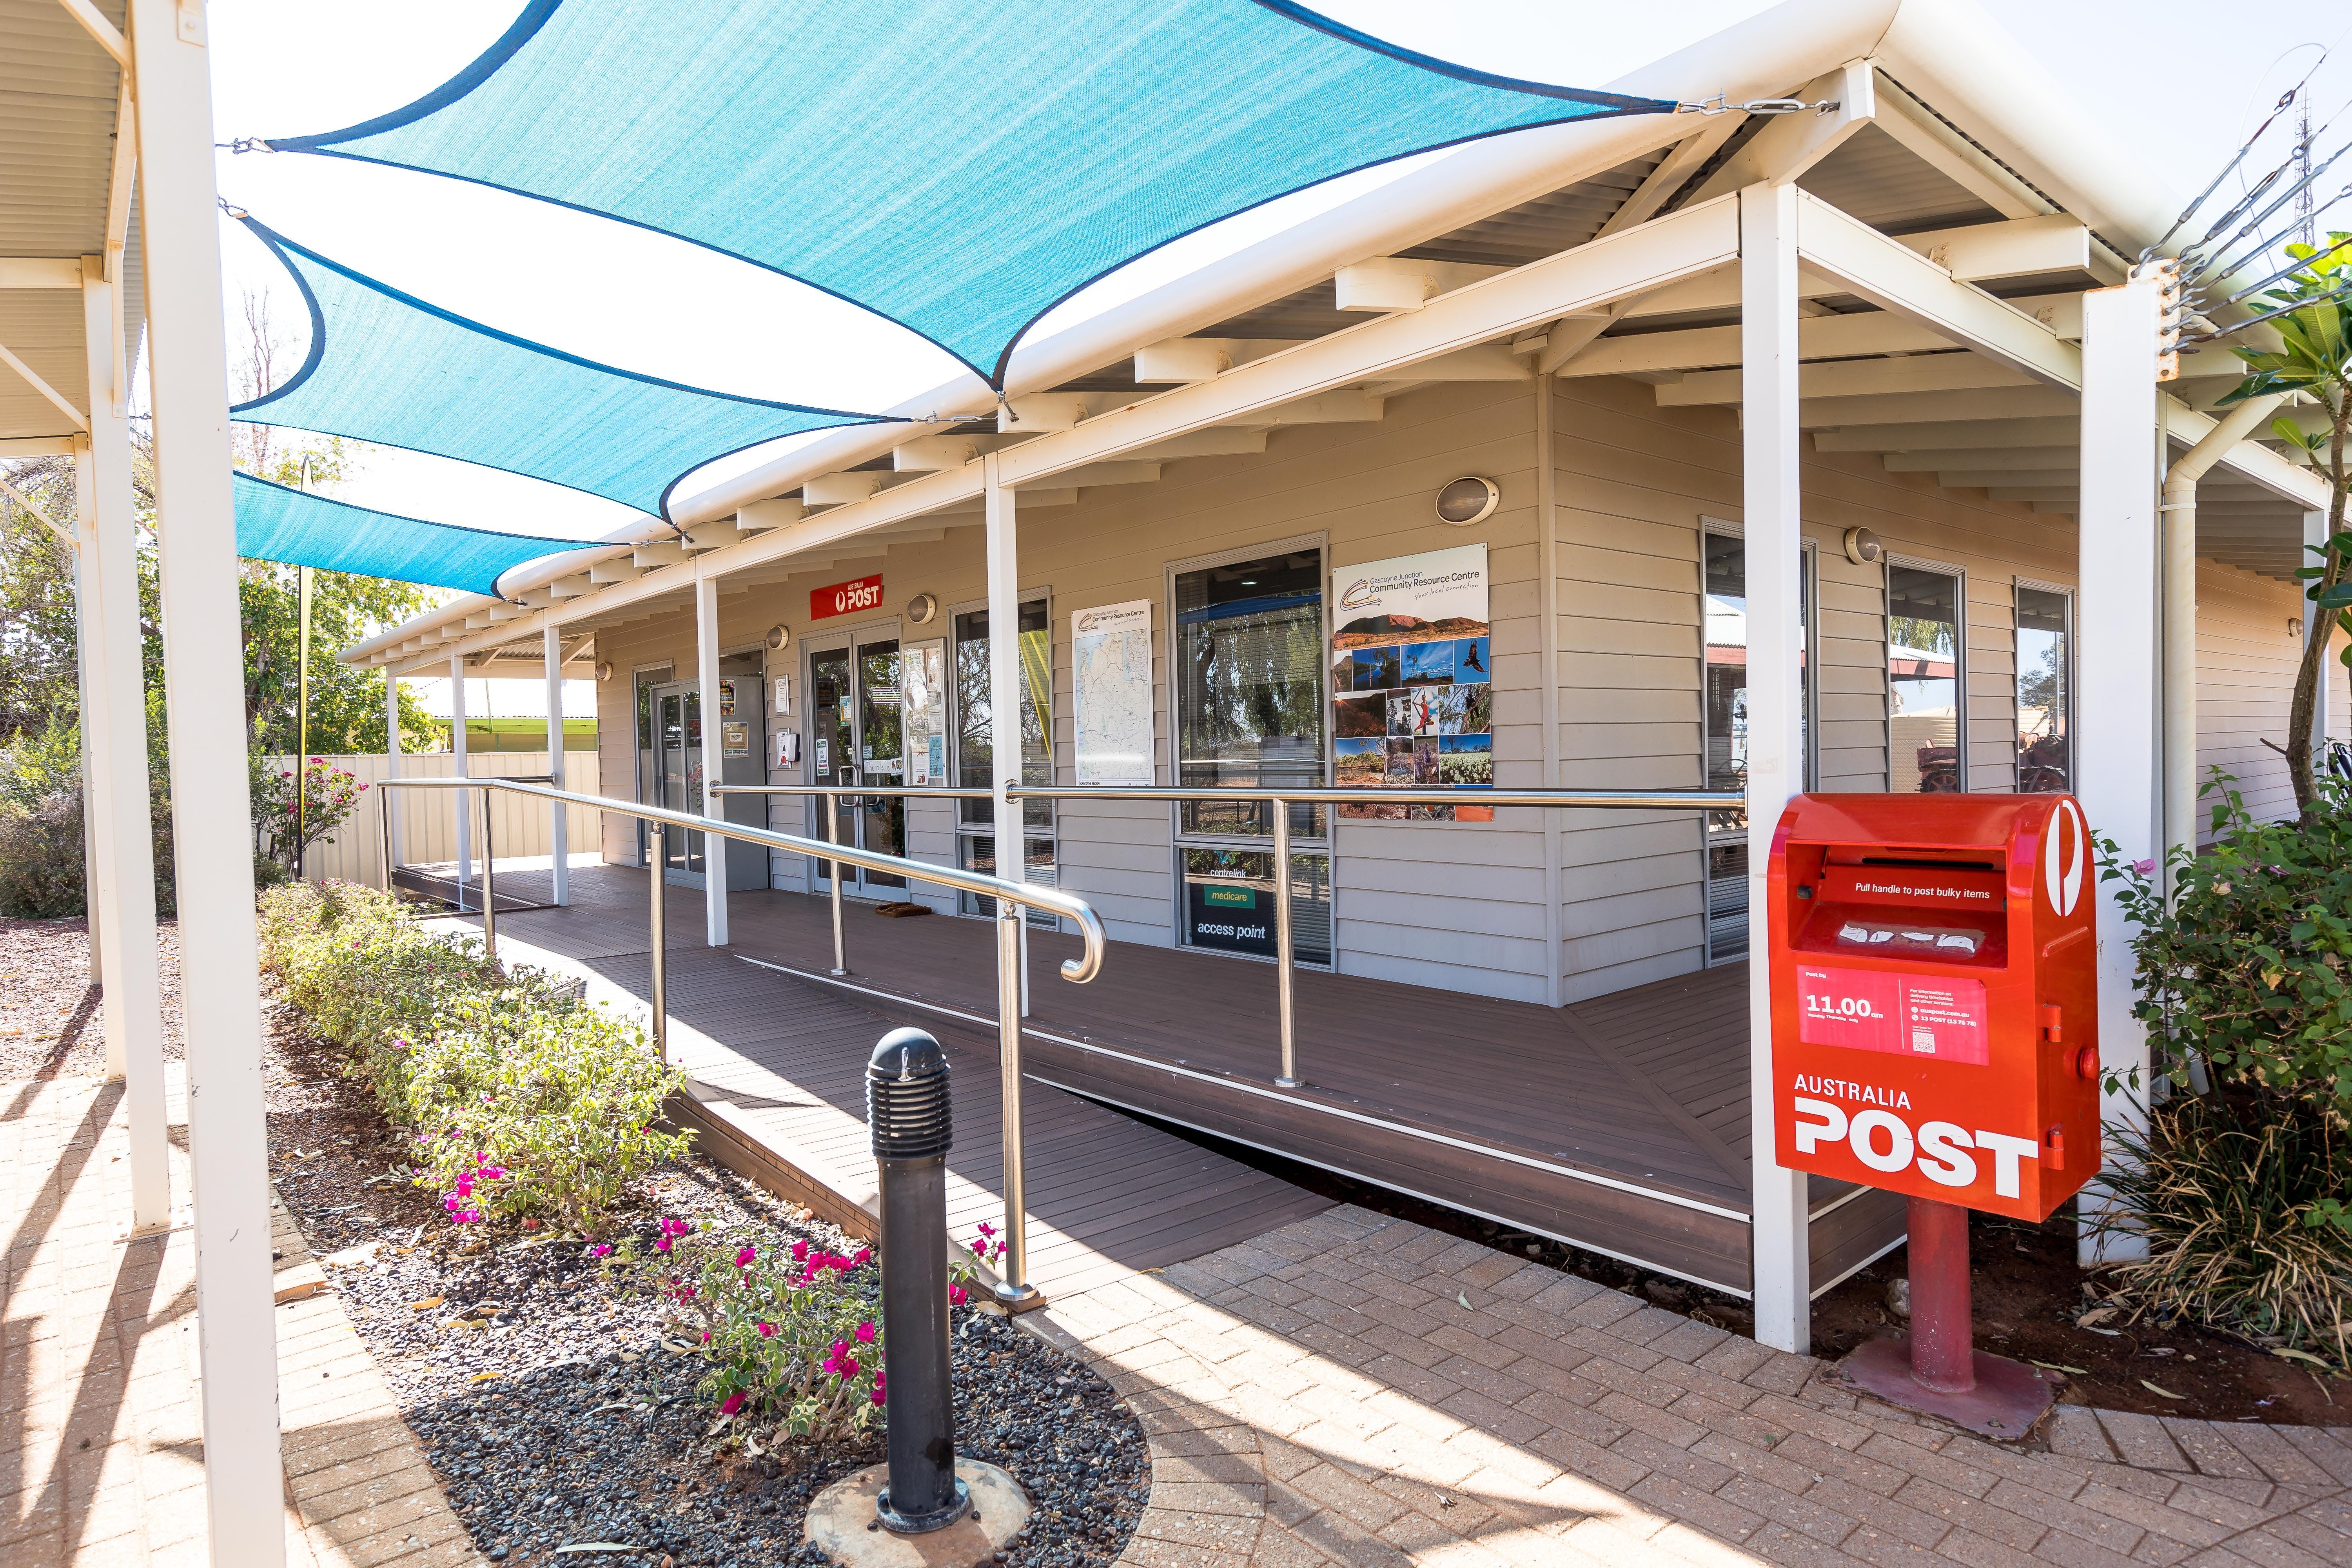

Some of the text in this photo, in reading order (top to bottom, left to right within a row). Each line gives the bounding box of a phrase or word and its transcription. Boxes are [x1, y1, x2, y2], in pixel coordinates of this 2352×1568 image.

[848, 581, 864, 591] AUSTRALIA
[1370, 571, 1423, 584] Gascoyne Junction
[1370, 571, 1479, 593] Community Resource Centre
[848, 586, 879, 609] POST
[1414, 581, 1478, 601] Your local connection
[1210, 869, 1246, 878] centrelink
[1212, 891, 1247, 902] medicare
[1856, 882, 1870, 892] Pull
[1872, 884, 1901, 894] handle
[1914, 887, 1934, 897] post
[1936, 887, 1961, 899] bulky
[1964, 889, 1990, 899] items
[1198, 922, 1265, 940] access point
[1920, 1009, 1970, 1018] auspost.com.au
[1794, 1074, 1911, 1110] AUSTRALIA
[1795, 1096, 2038, 1199] POST
